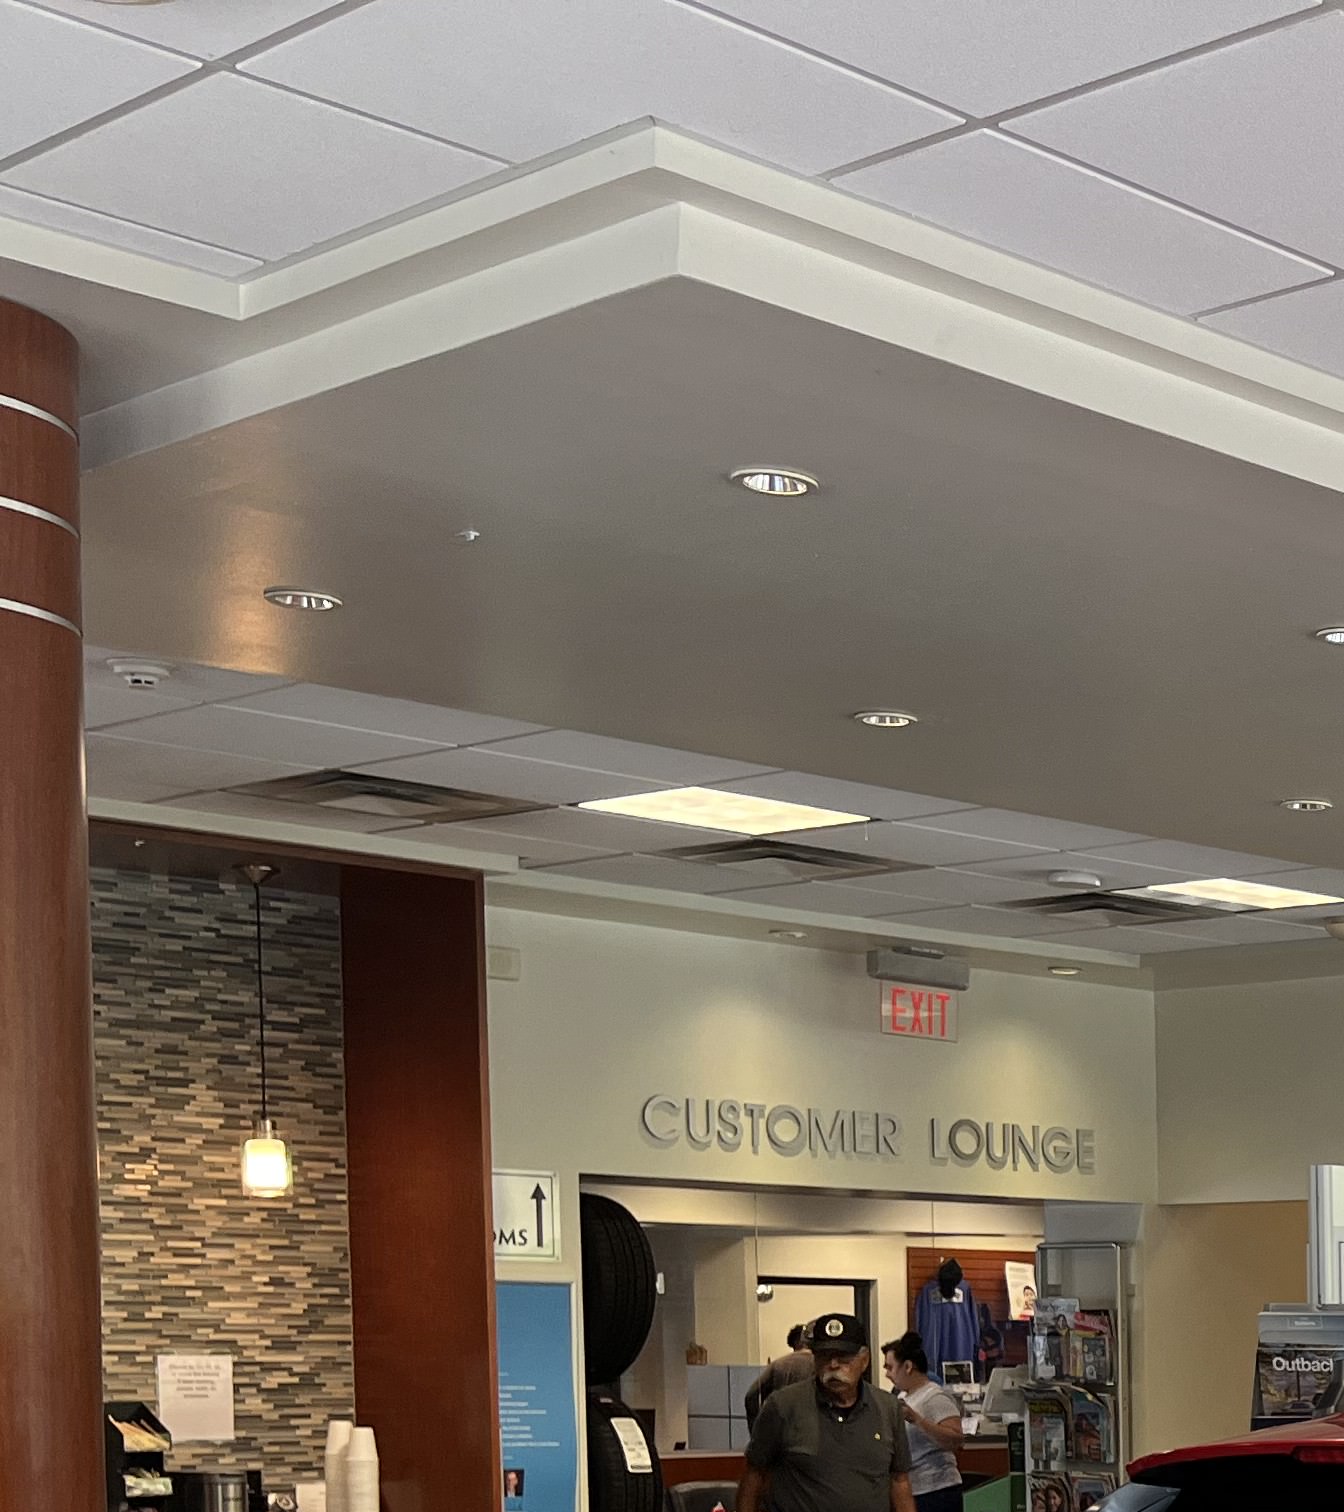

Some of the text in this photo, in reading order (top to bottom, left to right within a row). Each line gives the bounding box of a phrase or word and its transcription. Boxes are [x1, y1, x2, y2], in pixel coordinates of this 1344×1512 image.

[891, 987, 951, 1038] EXIT
[641, 1094, 1095, 1172] CUSTOMER LOUNGE
[493, 1229, 528, 1247] MS
